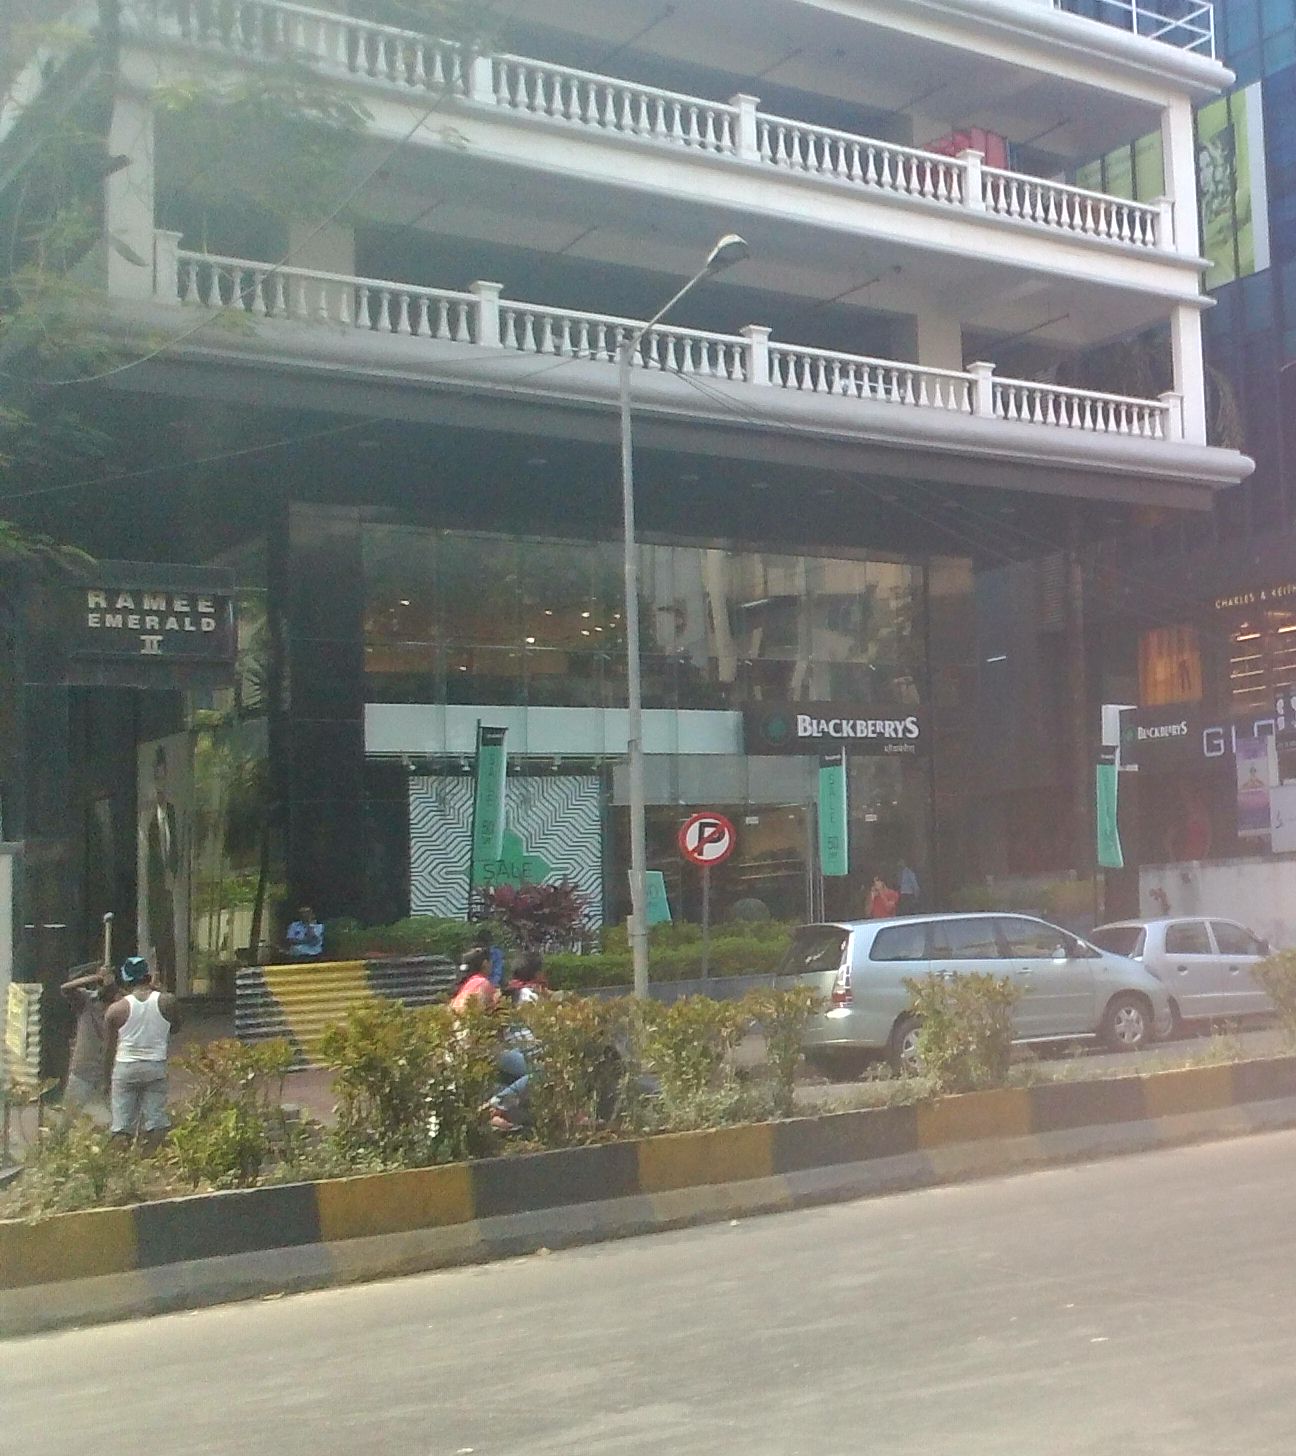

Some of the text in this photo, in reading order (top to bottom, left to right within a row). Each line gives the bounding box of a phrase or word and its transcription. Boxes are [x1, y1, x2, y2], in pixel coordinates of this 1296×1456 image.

[88, 590, 215, 612] RAMEE
[1215, 592, 1254, 609] CHARLES
[88, 612, 217, 632] EMERALD
[140, 634, 164, 655] II
[796, 714, 920, 739] BLACKBERRYS
[698, 821, 726, 857] P
[483, 859, 533, 880] SALE
